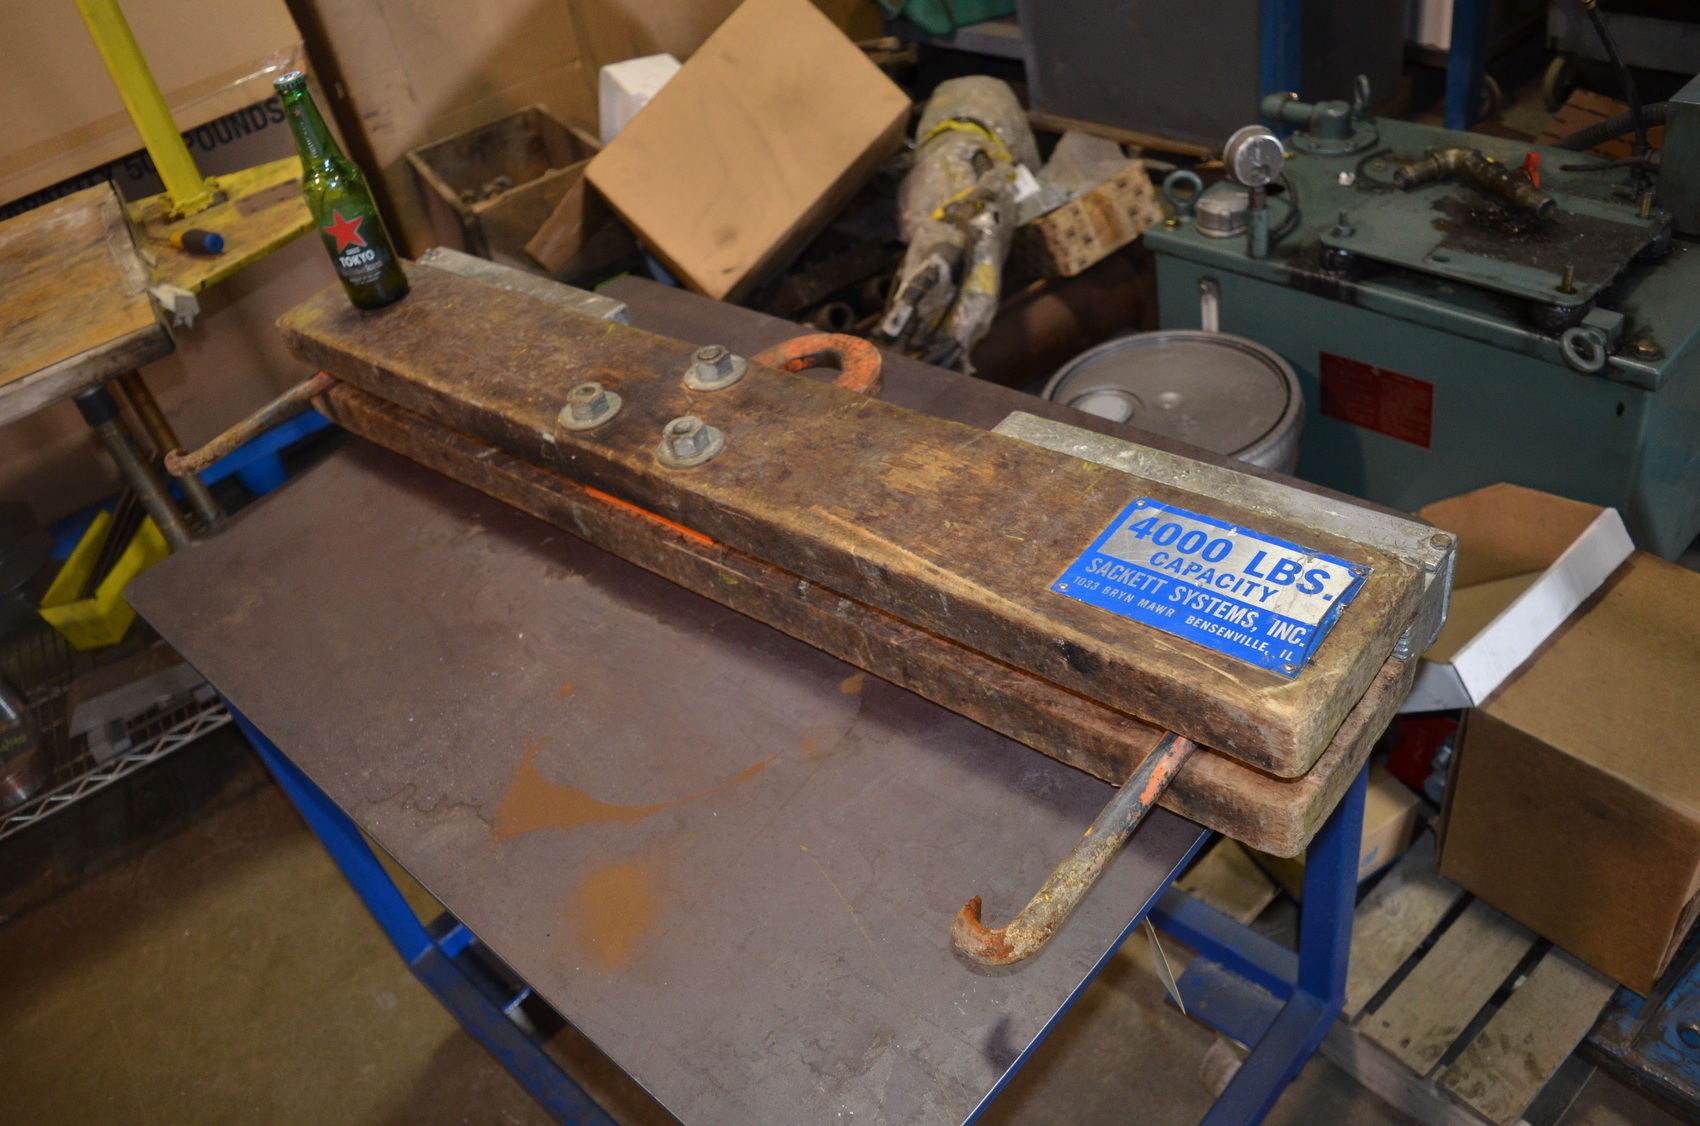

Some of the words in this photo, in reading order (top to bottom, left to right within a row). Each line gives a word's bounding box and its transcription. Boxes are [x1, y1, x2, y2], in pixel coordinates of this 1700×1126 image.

[339, 249, 375, 268] TOKYO
[1129, 516, 1233, 563] 4000
[1241, 550, 1334, 601] LBS.
[1149, 551, 1279, 603] CAPACITY
[1073, 576, 1100, 591] 1033
[1101, 586, 1135, 603] BRYN
[1137, 598, 1176, 618] MAWR
[1278, 649, 1293, 662] IL
[1085, 557, 1168, 595] SACKETT
[1168, 585, 1259, 633] SYSTEMS,
[1266, 617, 1307, 647] INC.
